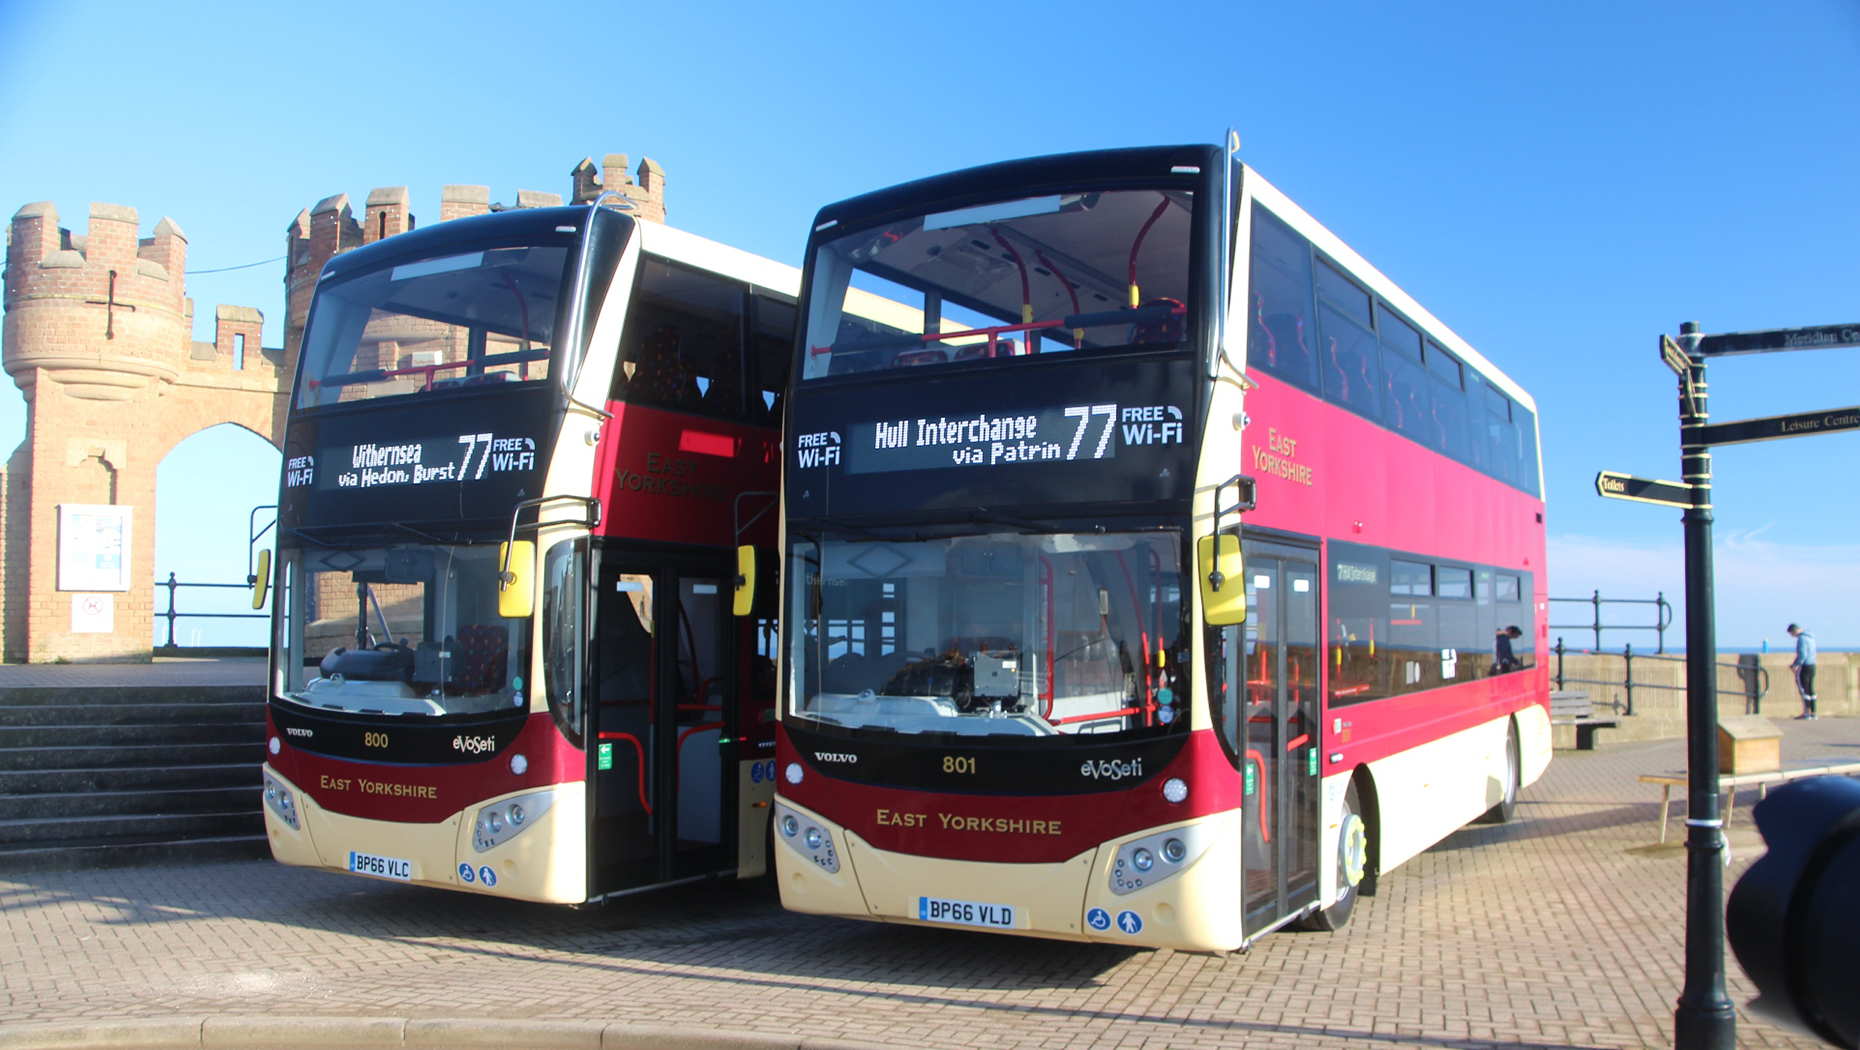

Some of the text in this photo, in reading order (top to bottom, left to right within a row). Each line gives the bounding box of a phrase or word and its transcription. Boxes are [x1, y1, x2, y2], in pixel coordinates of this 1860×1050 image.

[1122, 406, 1164, 422] FREE
[1782, 415, 1860, 432] Leisure Centre
[798, 432, 828, 448] FREE
[875, 414, 1037, 449] Hull Interchange
[1064, 404, 1117, 461] 77
[1122, 422, 1182, 445] Wi-Fi
[1269, 427, 1297, 458] EAST
[352, 443, 422, 468] Withernsea
[493, 438, 523, 452] FREE
[952, 441, 1060, 465] via Patrin
[288, 456, 307, 470] FREE
[457, 433, 493, 481] 77
[492, 452, 534, 472] Wi-Fi
[647, 452, 698, 478] EAST
[798, 446, 840, 468] Wi-Fi
[1252, 445, 1313, 487] YORKSHIRE
[287, 468, 313, 487] Wi-Fi
[338, 472, 358, 487] via
[413, 461, 456, 484] Burst
[615, 467, 727, 501] YORKSHIRE
[1603, 477, 1625, 492] Toilets
[286, 727, 313, 738] VOLVO
[364, 731, 389, 748] 800
[452, 735, 495, 754] eVoSeti
[814, 751, 858, 763] VOLVO
[942, 755, 976, 774] 801
[1080, 757, 1142, 780] eVoSeti
[320, 774, 437, 799] EAST YORKSHIRE
[876, 809, 1062, 835] EAST YORKSHIRE
[356, 855, 409, 878] BP66 VLC
[930, 900, 1011, 926] BP66 VLD
